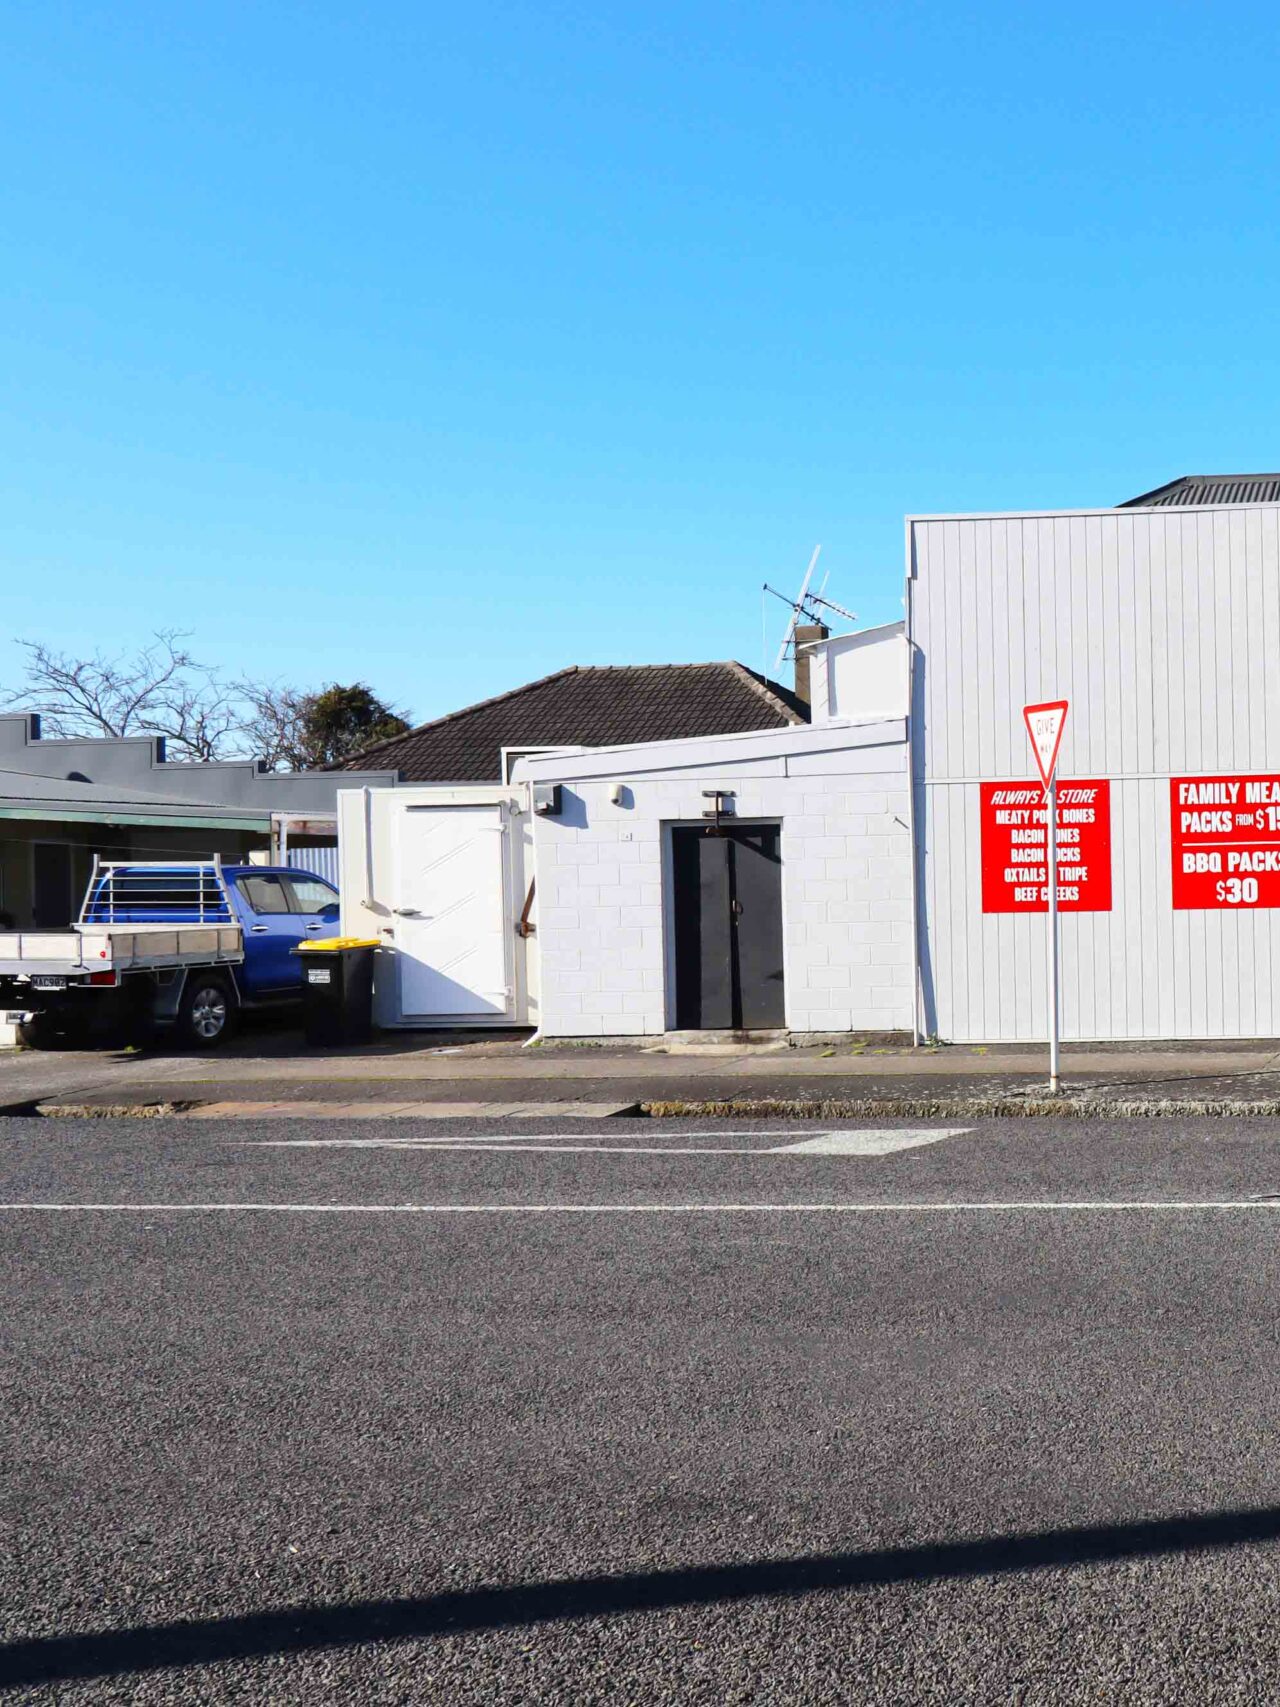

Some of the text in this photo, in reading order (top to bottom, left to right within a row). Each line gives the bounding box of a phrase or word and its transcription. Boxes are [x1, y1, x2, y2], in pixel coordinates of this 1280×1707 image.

[991, 790, 1041, 805] ALWAYS
[1057, 789, 1098, 804] STORE
[1179, 782, 1240, 805] FAMILY
[995, 808, 1095, 824] MEATY POK BONES
[1181, 811, 1232, 833] PACKS
[1235, 813, 1254, 826] FROM
[1011, 828, 1080, 844] BACON ONES
[1011, 847, 1081, 863] BACON OCKS
[1182, 852, 1222, 873] BBQ
[1004, 866, 1088, 882] OXTAILS TRIPE
[1014, 886, 1079, 902] BEEF CEEKS
[1216, 877, 1258, 903] $30
